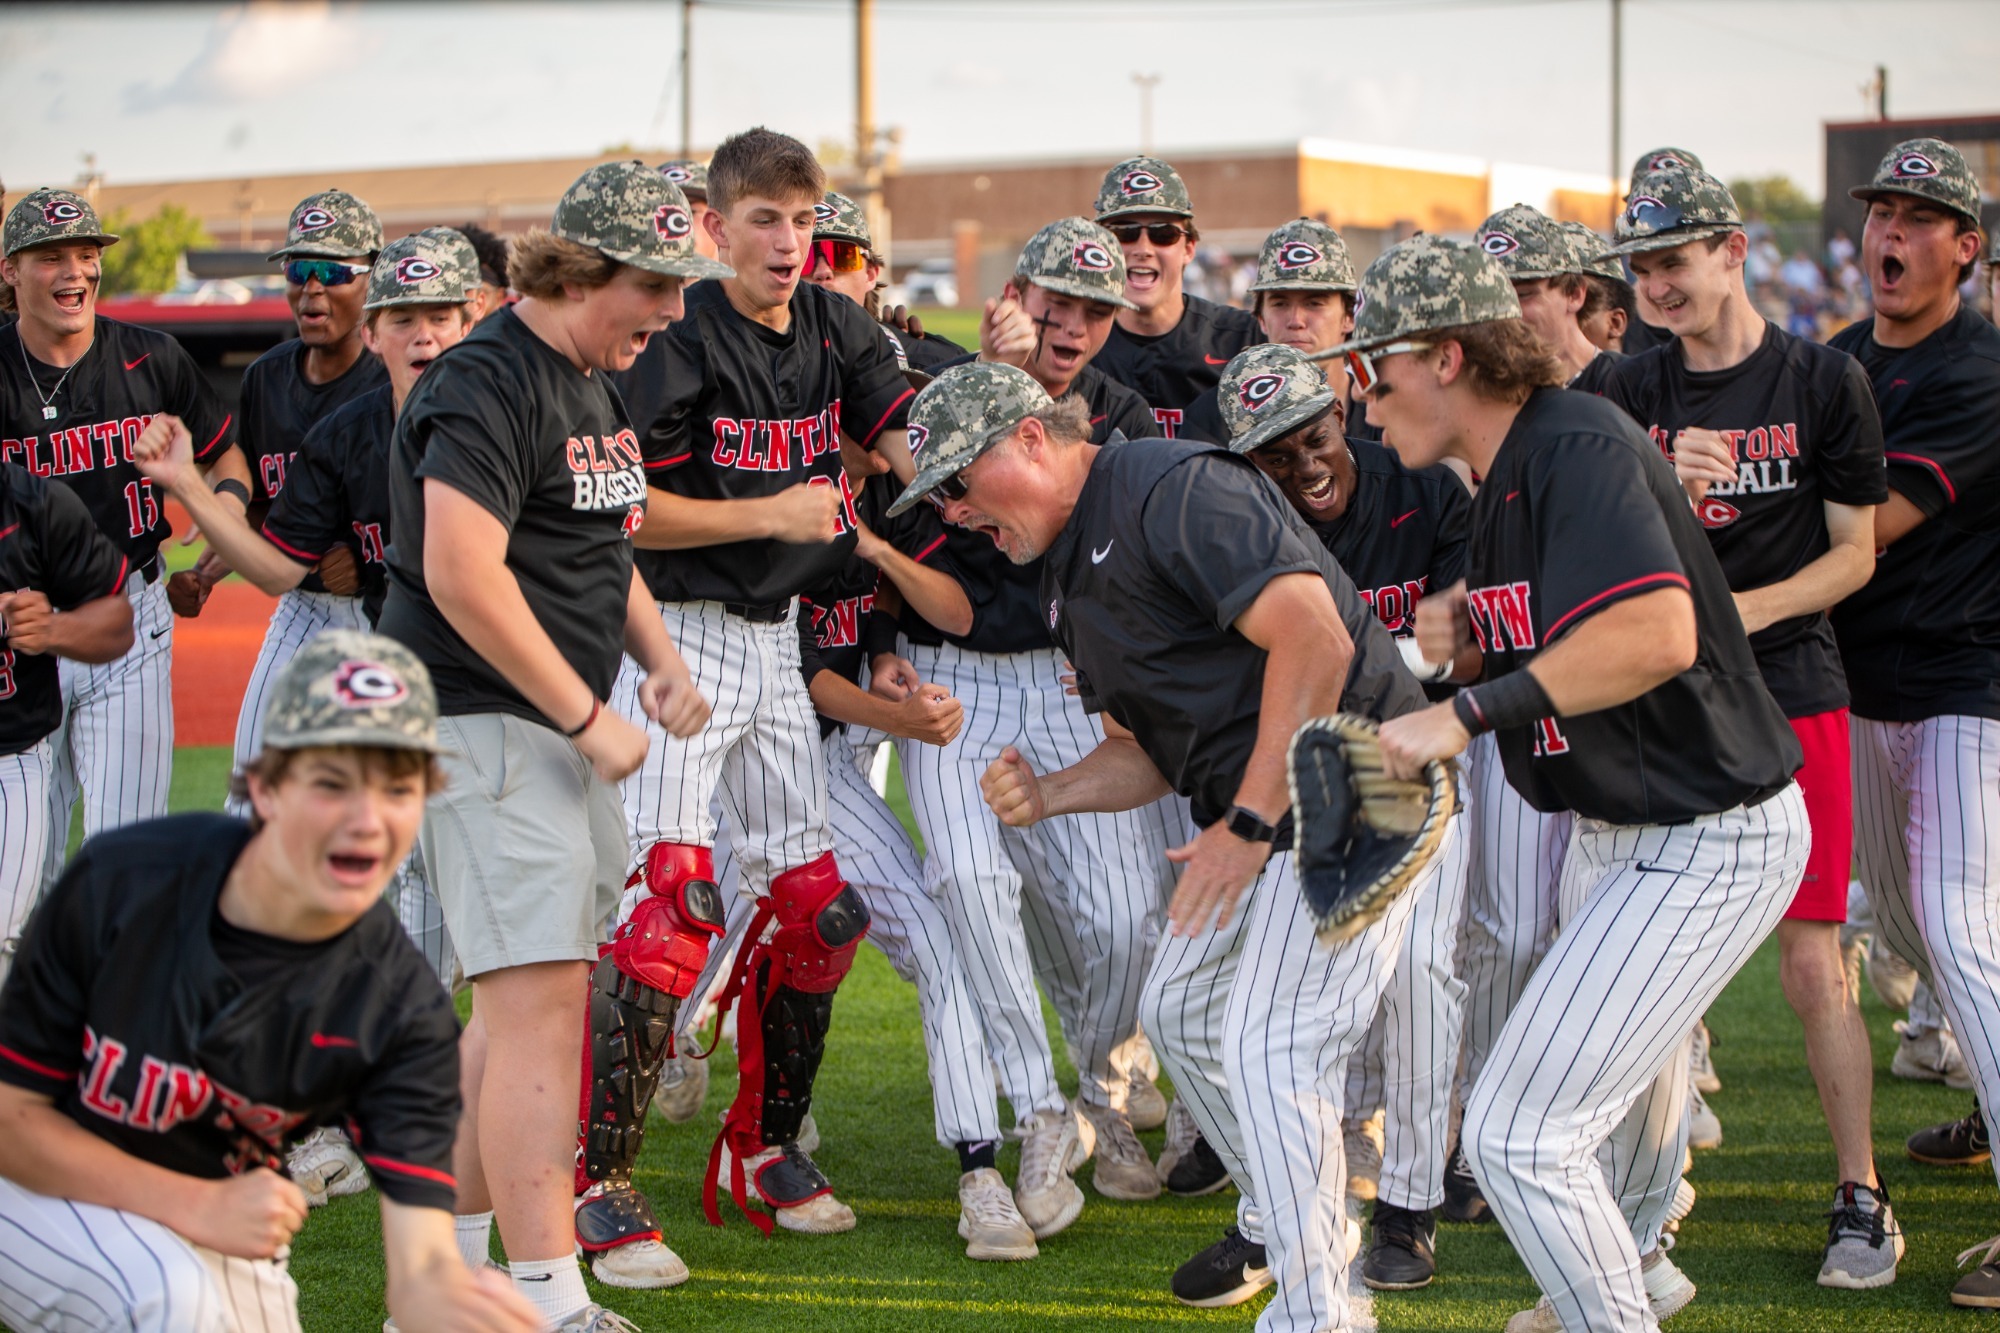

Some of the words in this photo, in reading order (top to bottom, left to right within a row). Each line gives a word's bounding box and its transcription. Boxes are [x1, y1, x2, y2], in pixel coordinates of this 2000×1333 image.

[1901, 158, 1930, 173] C
[1130, 174, 1156, 189] C
[54, 204, 80, 218] C
[304, 211, 328, 226] C
[667, 212, 690, 233] C
[1288, 247, 1314, 262] C
[1485, 237, 1509, 255] C
[1085, 245, 1109, 266] C
[406, 262, 433, 278] C
[1250, 378, 1277, 399] C
[1149, 407, 1183, 440] T
[2, 413, 161, 478] CLINTO
[1649, 423, 1800, 463] LTON
[1705, 504, 1731, 522] C
[350, 669, 397, 698] C
